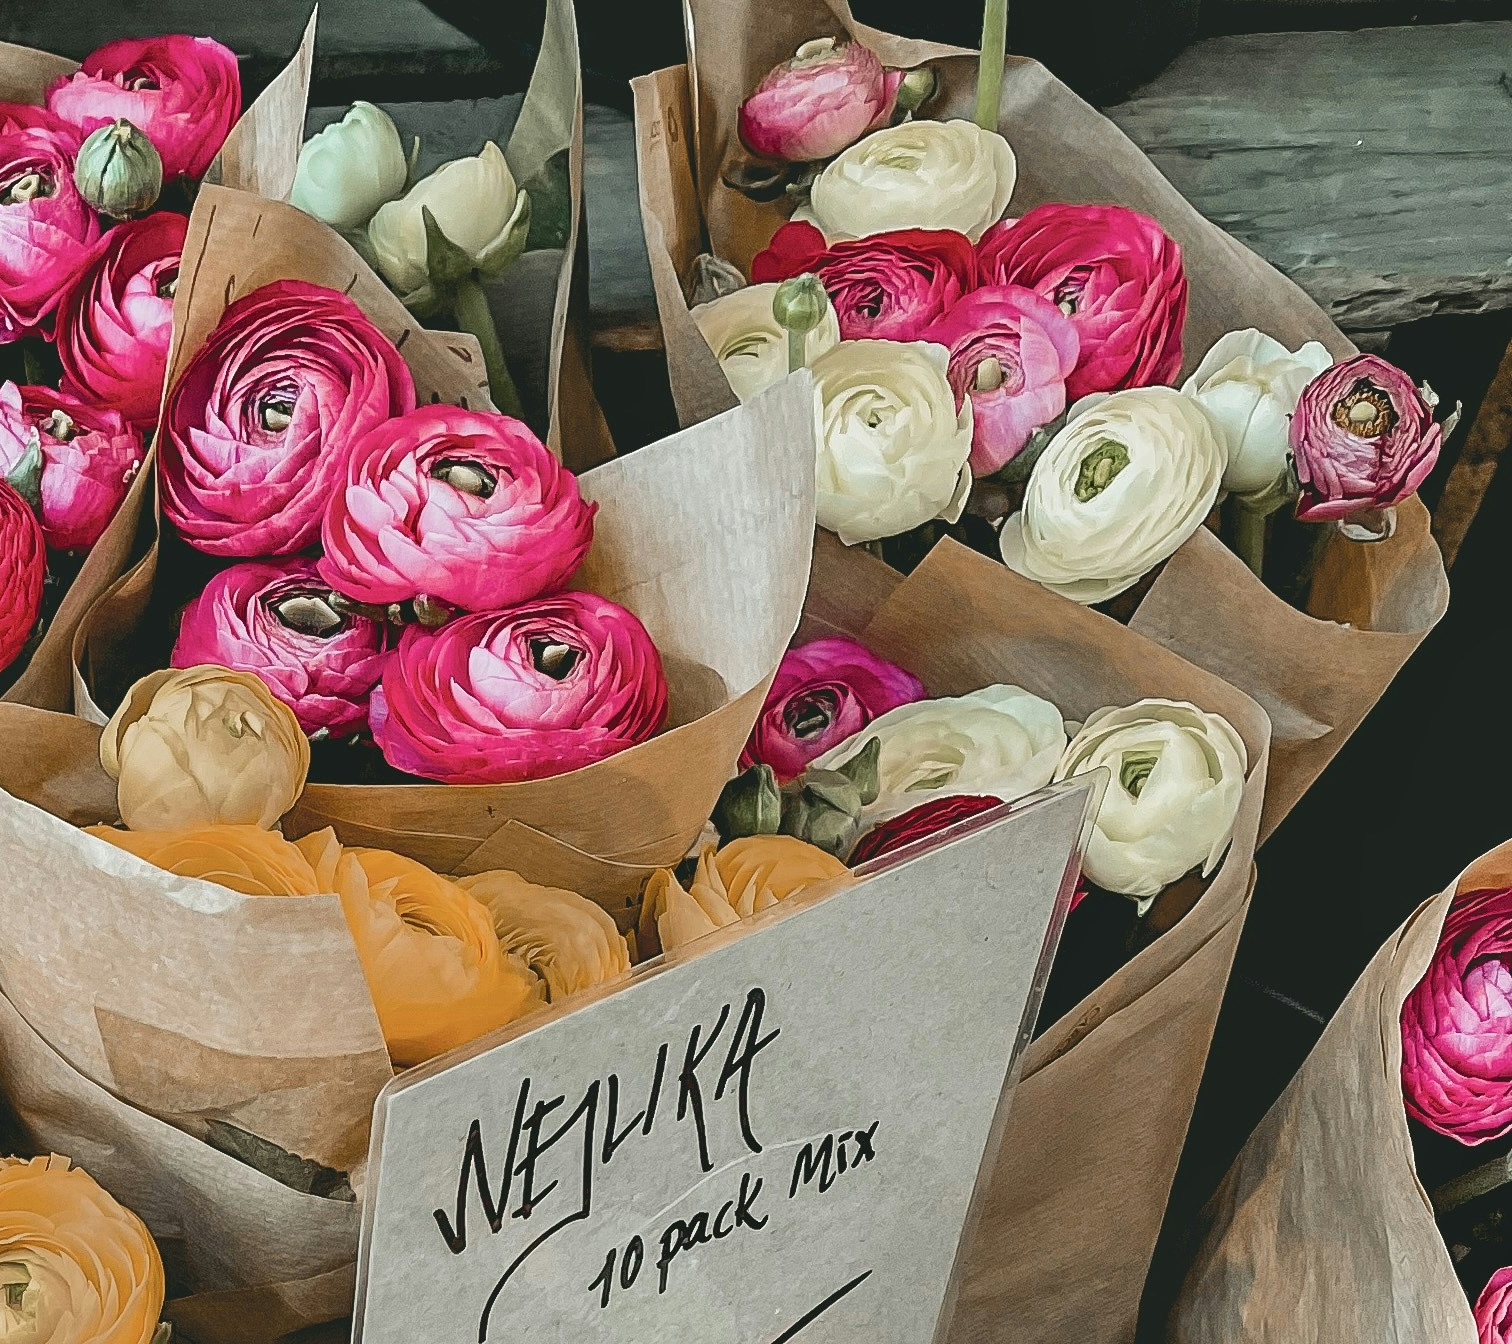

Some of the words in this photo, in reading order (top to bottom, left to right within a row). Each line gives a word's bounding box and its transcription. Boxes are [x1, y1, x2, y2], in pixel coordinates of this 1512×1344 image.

[433, 987, 780, 1344] NEJLIKA
[588, 1234, 644, 1308] 10
[656, 1172, 769, 1295] pack
[789, 1119, 880, 1200] Mix
